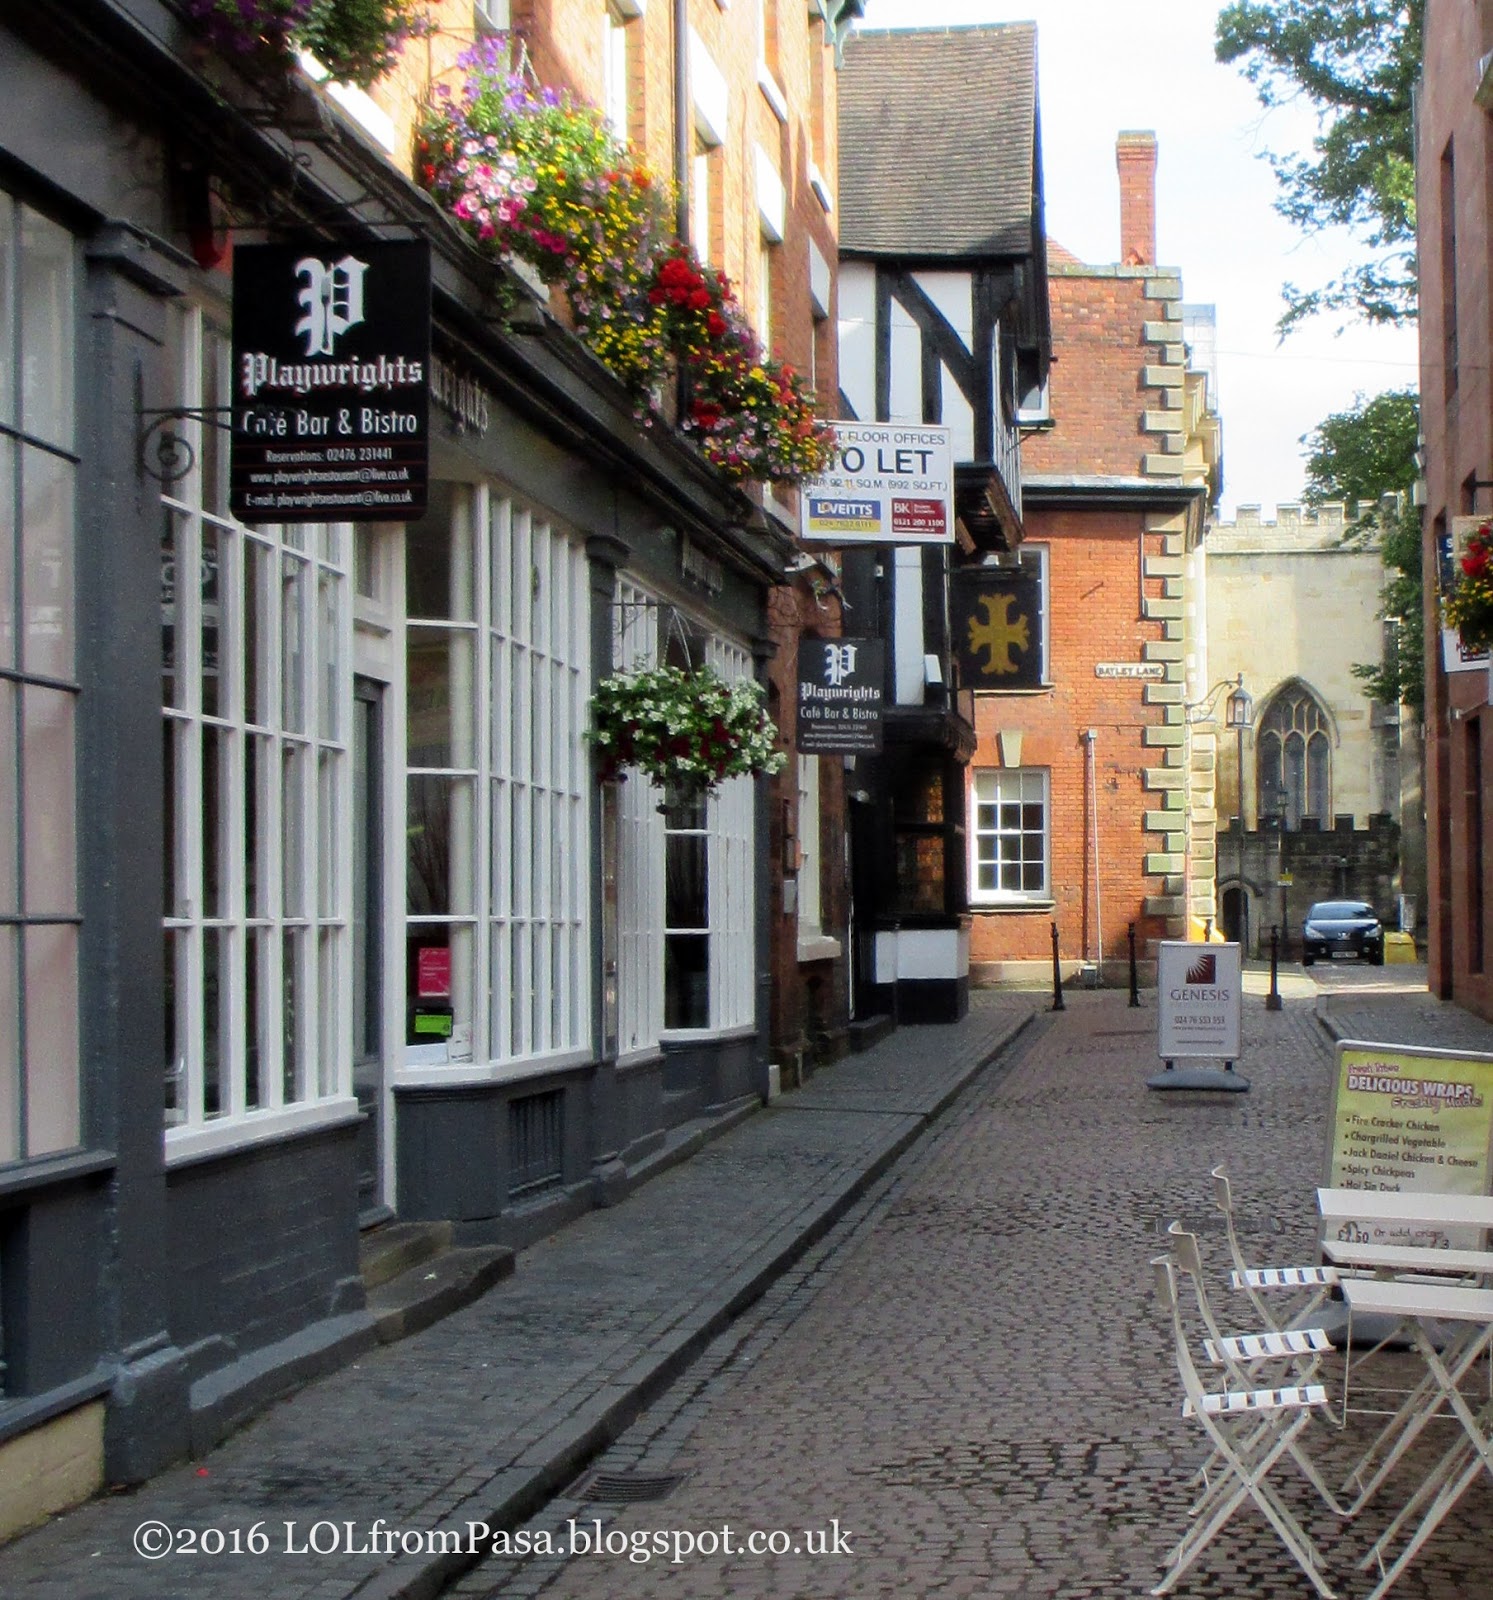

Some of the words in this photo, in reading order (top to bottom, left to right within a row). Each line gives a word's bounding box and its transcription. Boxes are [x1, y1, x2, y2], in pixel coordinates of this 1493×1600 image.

[242, 352, 423, 396] Playwrights
[243, 410, 287, 436] Caé
[297, 409, 330, 435] Bar
[338, 408, 353, 434] &
[361, 407, 417, 434] Bistro
[848, 431, 890, 443] FLOOR
[894, 432, 945, 445] OFFICES
[266, 450, 324, 463] Reservations:
[326, 448, 356, 461] 02476
[359, 447, 392, 460] 231441
[877, 448, 934, 474] LET
[888, 480, 909, 490] (992
[817, 502, 873, 516] LOVEITTS
[894, 502, 910, 513] BK
[1098, 667, 1134, 675] BAYLEY
[1137, 667, 1161, 675] LANE
[800, 681, 880, 701] Playwrights
[800, 706, 821, 719] Café
[824, 707, 840, 719] Bar
[842, 707, 850, 719] &
[852, 707, 879, 720] Bistro
[1171, 989, 1230, 1001] GENESIS
[1348, 1075, 1419, 1095] DELICIOUS
[1423, 1081, 1473, 1099] WRAPS
[1352, 1115, 1368, 1126] Fire
[1371, 1117, 1403, 1128] Cracker
[1406, 1120, 1440, 1132] Chicken
[1350, 1131, 1399, 1145] Chargrilled
[1402, 1136, 1446, 1149] Vegetable
[1348, 1148, 1367, 1157] Jack
[1370, 1149, 1399, 1160] Daniel
[1402, 1152, 1435, 1163] Chicken
[1437, 1155, 1444, 1164] &
[1447, 1156, 1478, 1167] Cheese
[1347, 1164, 1369, 1176] Spicy
[1372, 1165, 1415, 1178] Chickpeas
[1364, 1181, 1377, 1191] Sin
[1380, 1182, 1400, 1192] Duck
